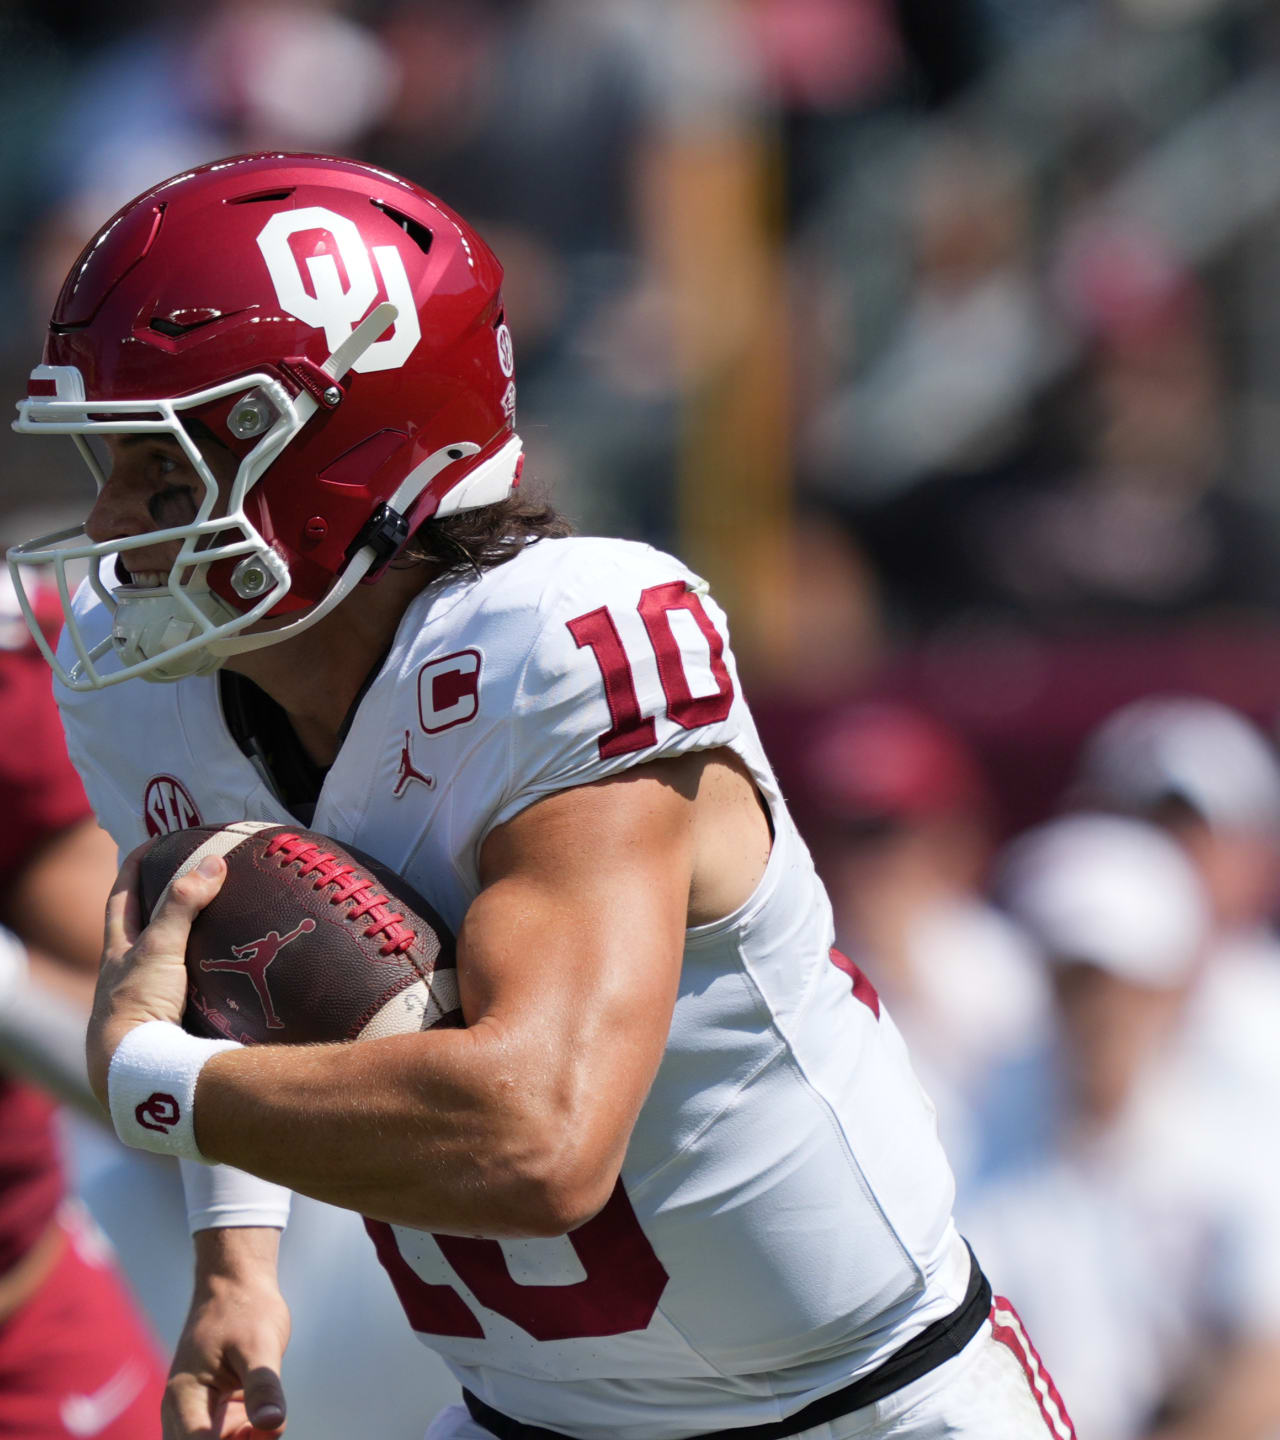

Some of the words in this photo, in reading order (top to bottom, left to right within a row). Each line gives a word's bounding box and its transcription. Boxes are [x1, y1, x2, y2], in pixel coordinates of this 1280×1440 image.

[256, 206, 422, 374] OU
[419, 651, 479, 733] C
[565, 579, 735, 761] 10
